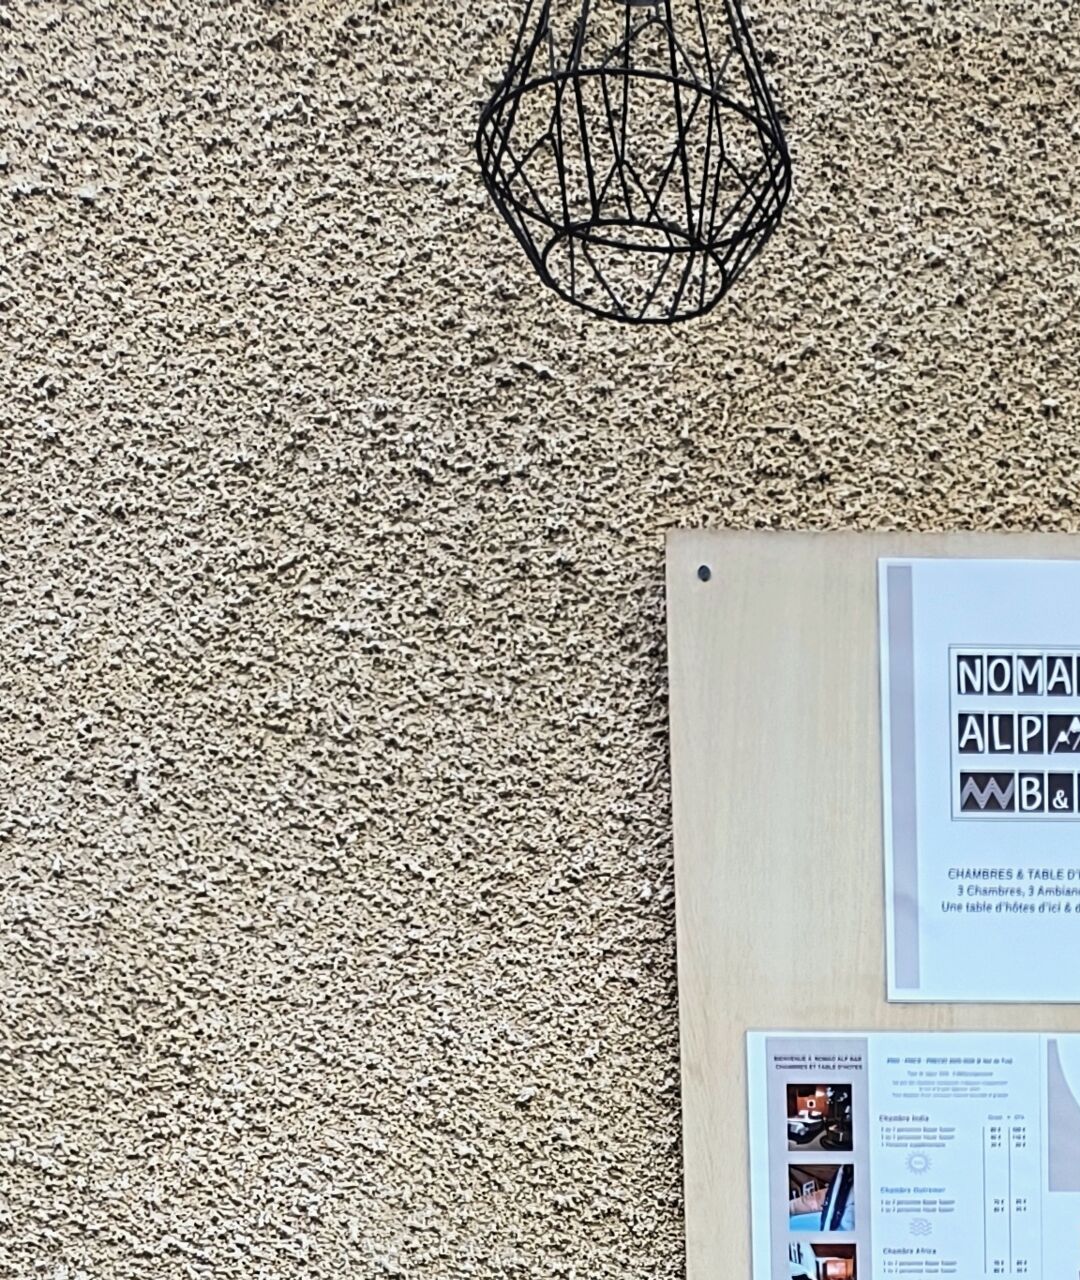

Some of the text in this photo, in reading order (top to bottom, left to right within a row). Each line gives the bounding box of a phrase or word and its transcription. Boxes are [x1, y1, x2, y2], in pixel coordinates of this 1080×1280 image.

[958, 715, 1042, 753] ALP
[948, 868, 1013, 880] CHAMBRES
[1027, 868, 1064, 880] TABLE
[957, 884, 964, 897] 3
[966, 884, 1025, 898] Chambres,
[1028, 885, 1035, 897] 3
[941, 901, 963, 913] Une
[965, 901, 993, 913] table
[1038, 901, 1061, 914] d'ici
